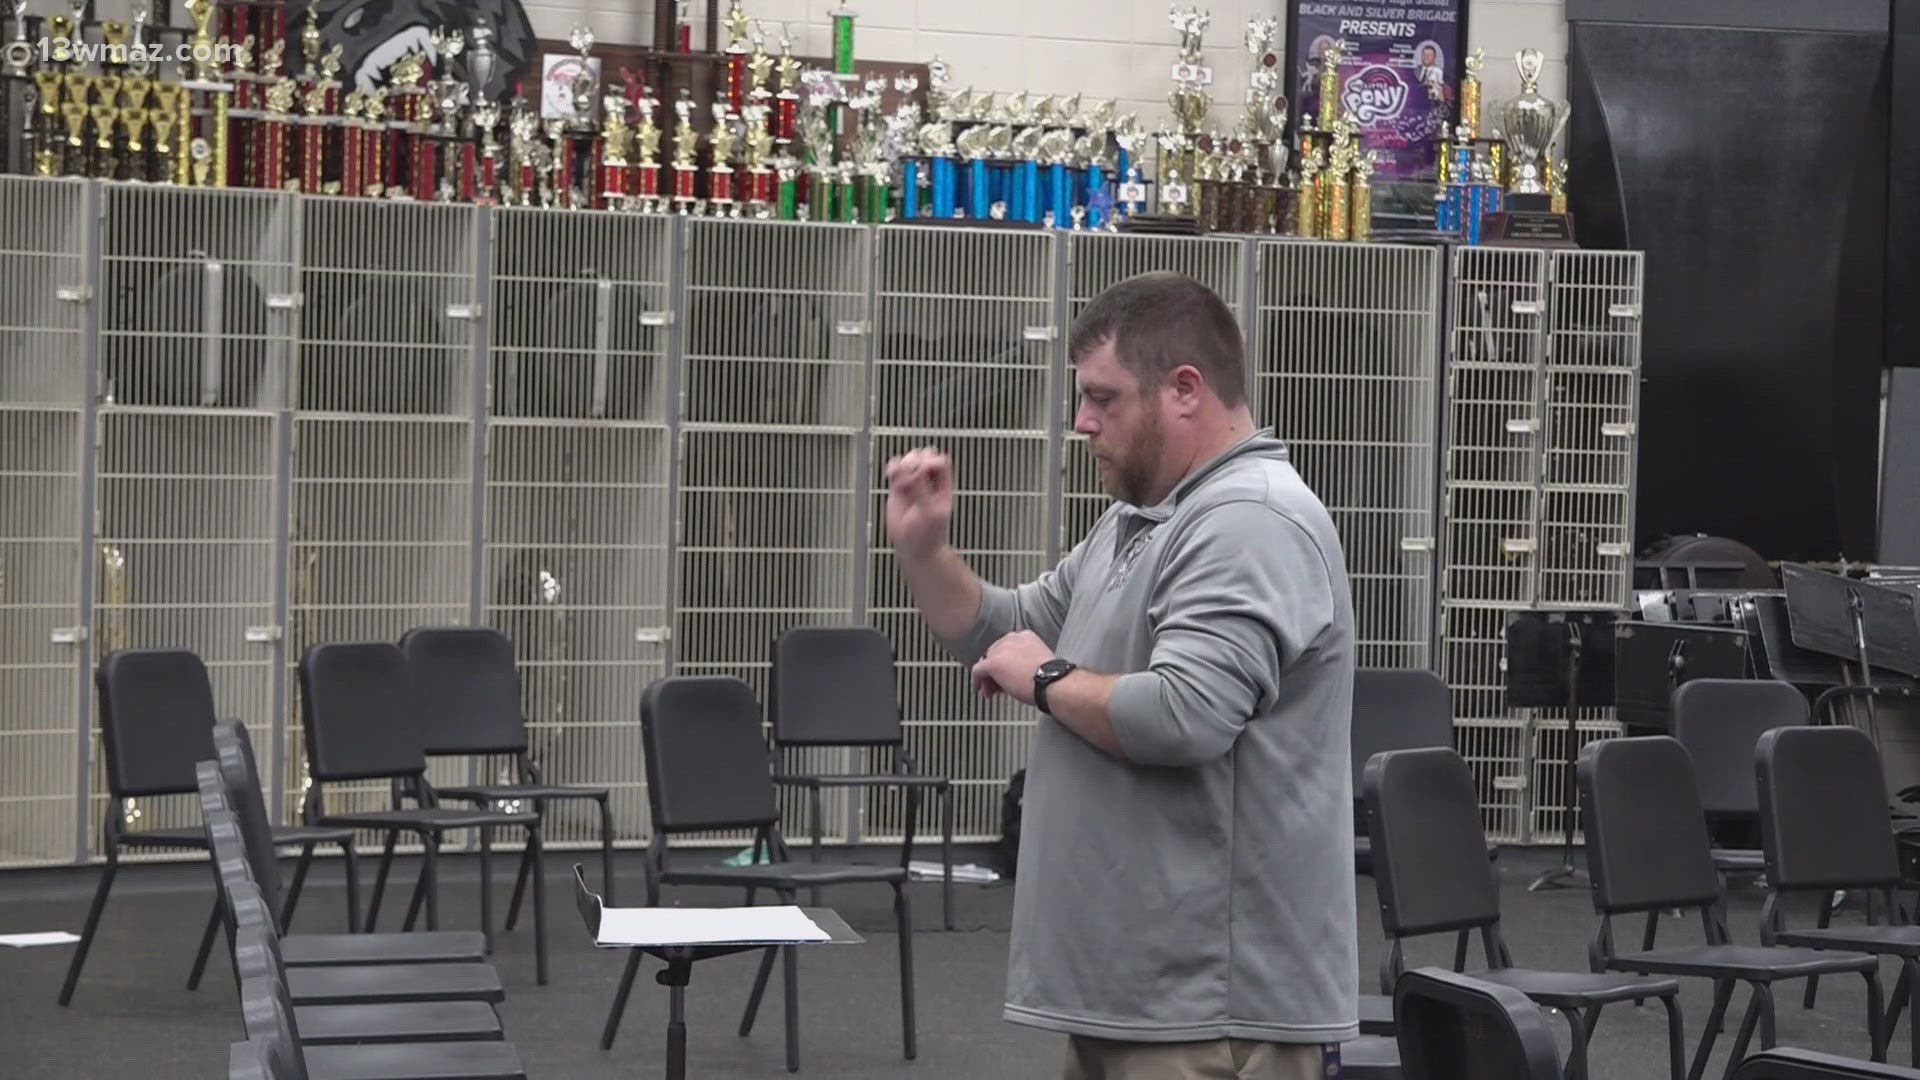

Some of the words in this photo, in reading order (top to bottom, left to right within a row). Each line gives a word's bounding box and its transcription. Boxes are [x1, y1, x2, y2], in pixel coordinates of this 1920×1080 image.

[1299, 3, 1337, 16] BLACK
[1338, 5, 1364, 18] AND
[1365, 7, 1406, 19] SILVER
[1407, 9, 1457, 22] BRIGADE
[1339, 20, 1416, 37] PRESENTS
